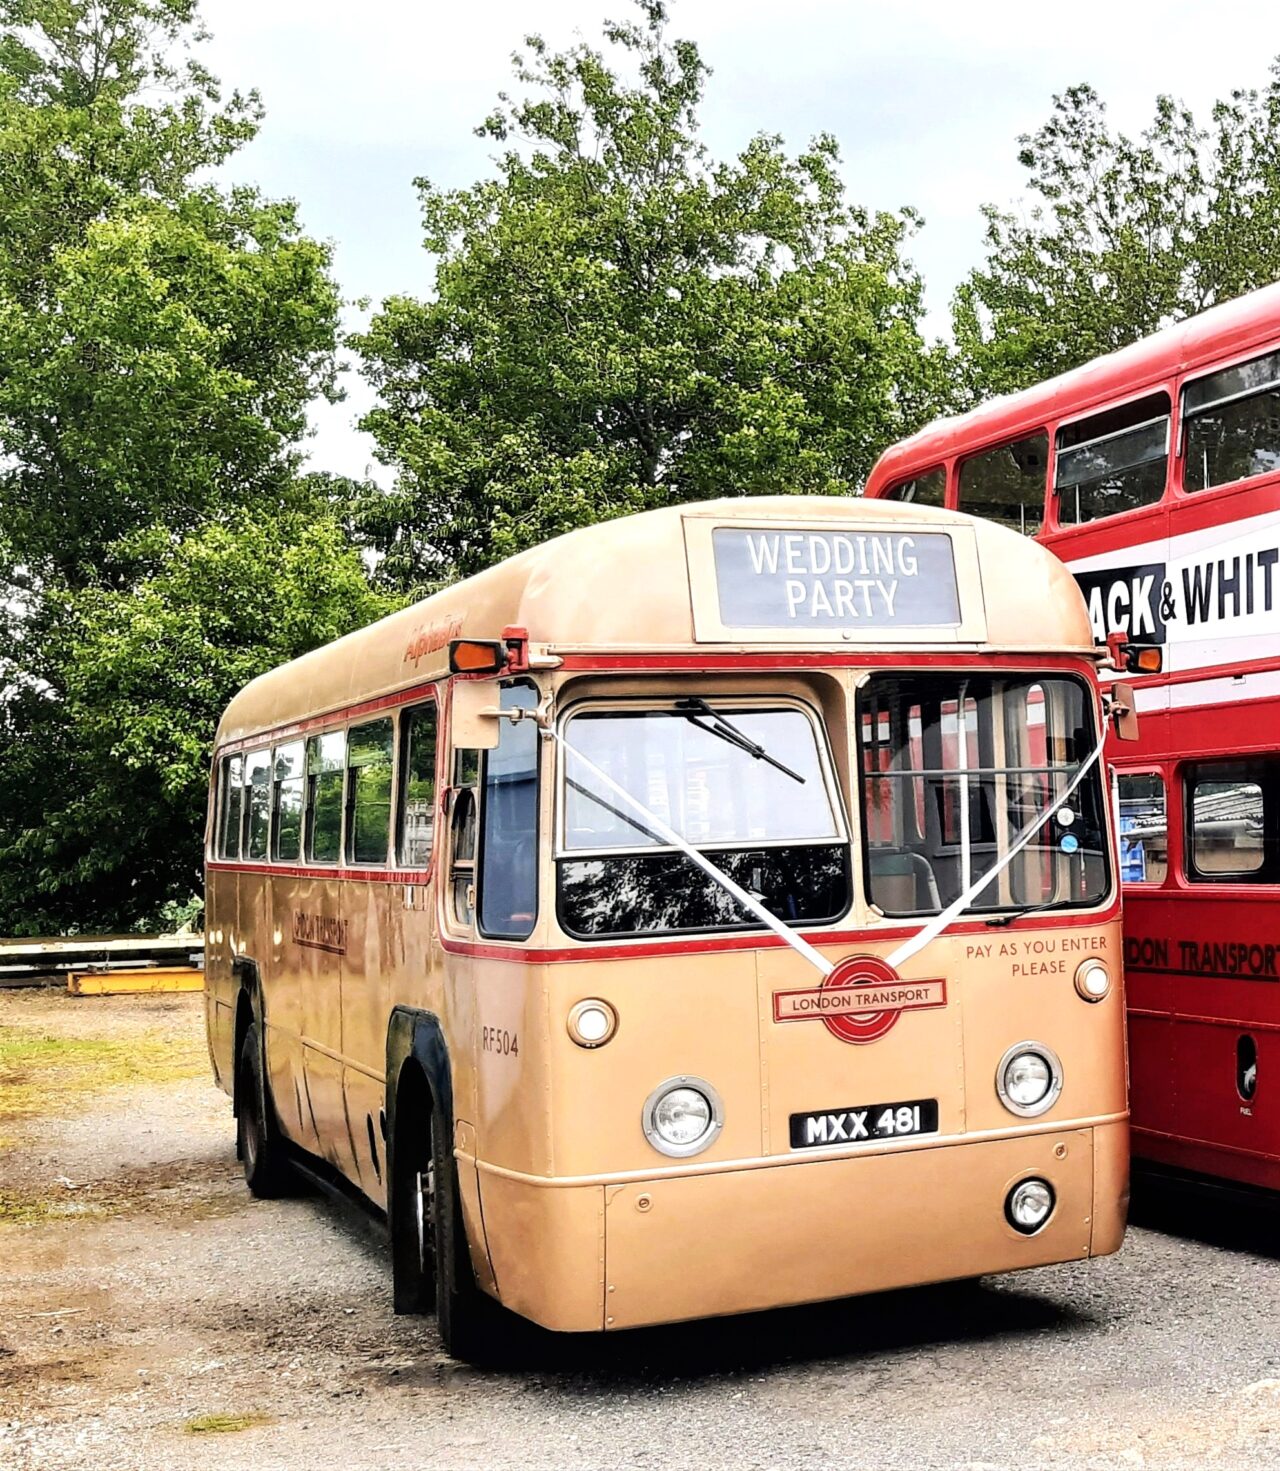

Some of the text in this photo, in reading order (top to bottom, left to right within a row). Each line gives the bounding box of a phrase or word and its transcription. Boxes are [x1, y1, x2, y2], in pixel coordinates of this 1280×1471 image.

[746, 534, 919, 577] WEDDING
[786, 579, 898, 618] PARTY
[1088, 574, 1156, 643] ACK
[1160, 581, 1177, 623] &
[966, 936, 1107, 959] PAY AS YOU ENTER
[1124, 937, 1169, 967] DON
[1012, 960, 1066, 977] PLEASE
[792, 988, 931, 1011] LONDON TRANSPORT
[482, 1025, 519, 1058] RF504
[806, 1105, 920, 1144] MXX 481
